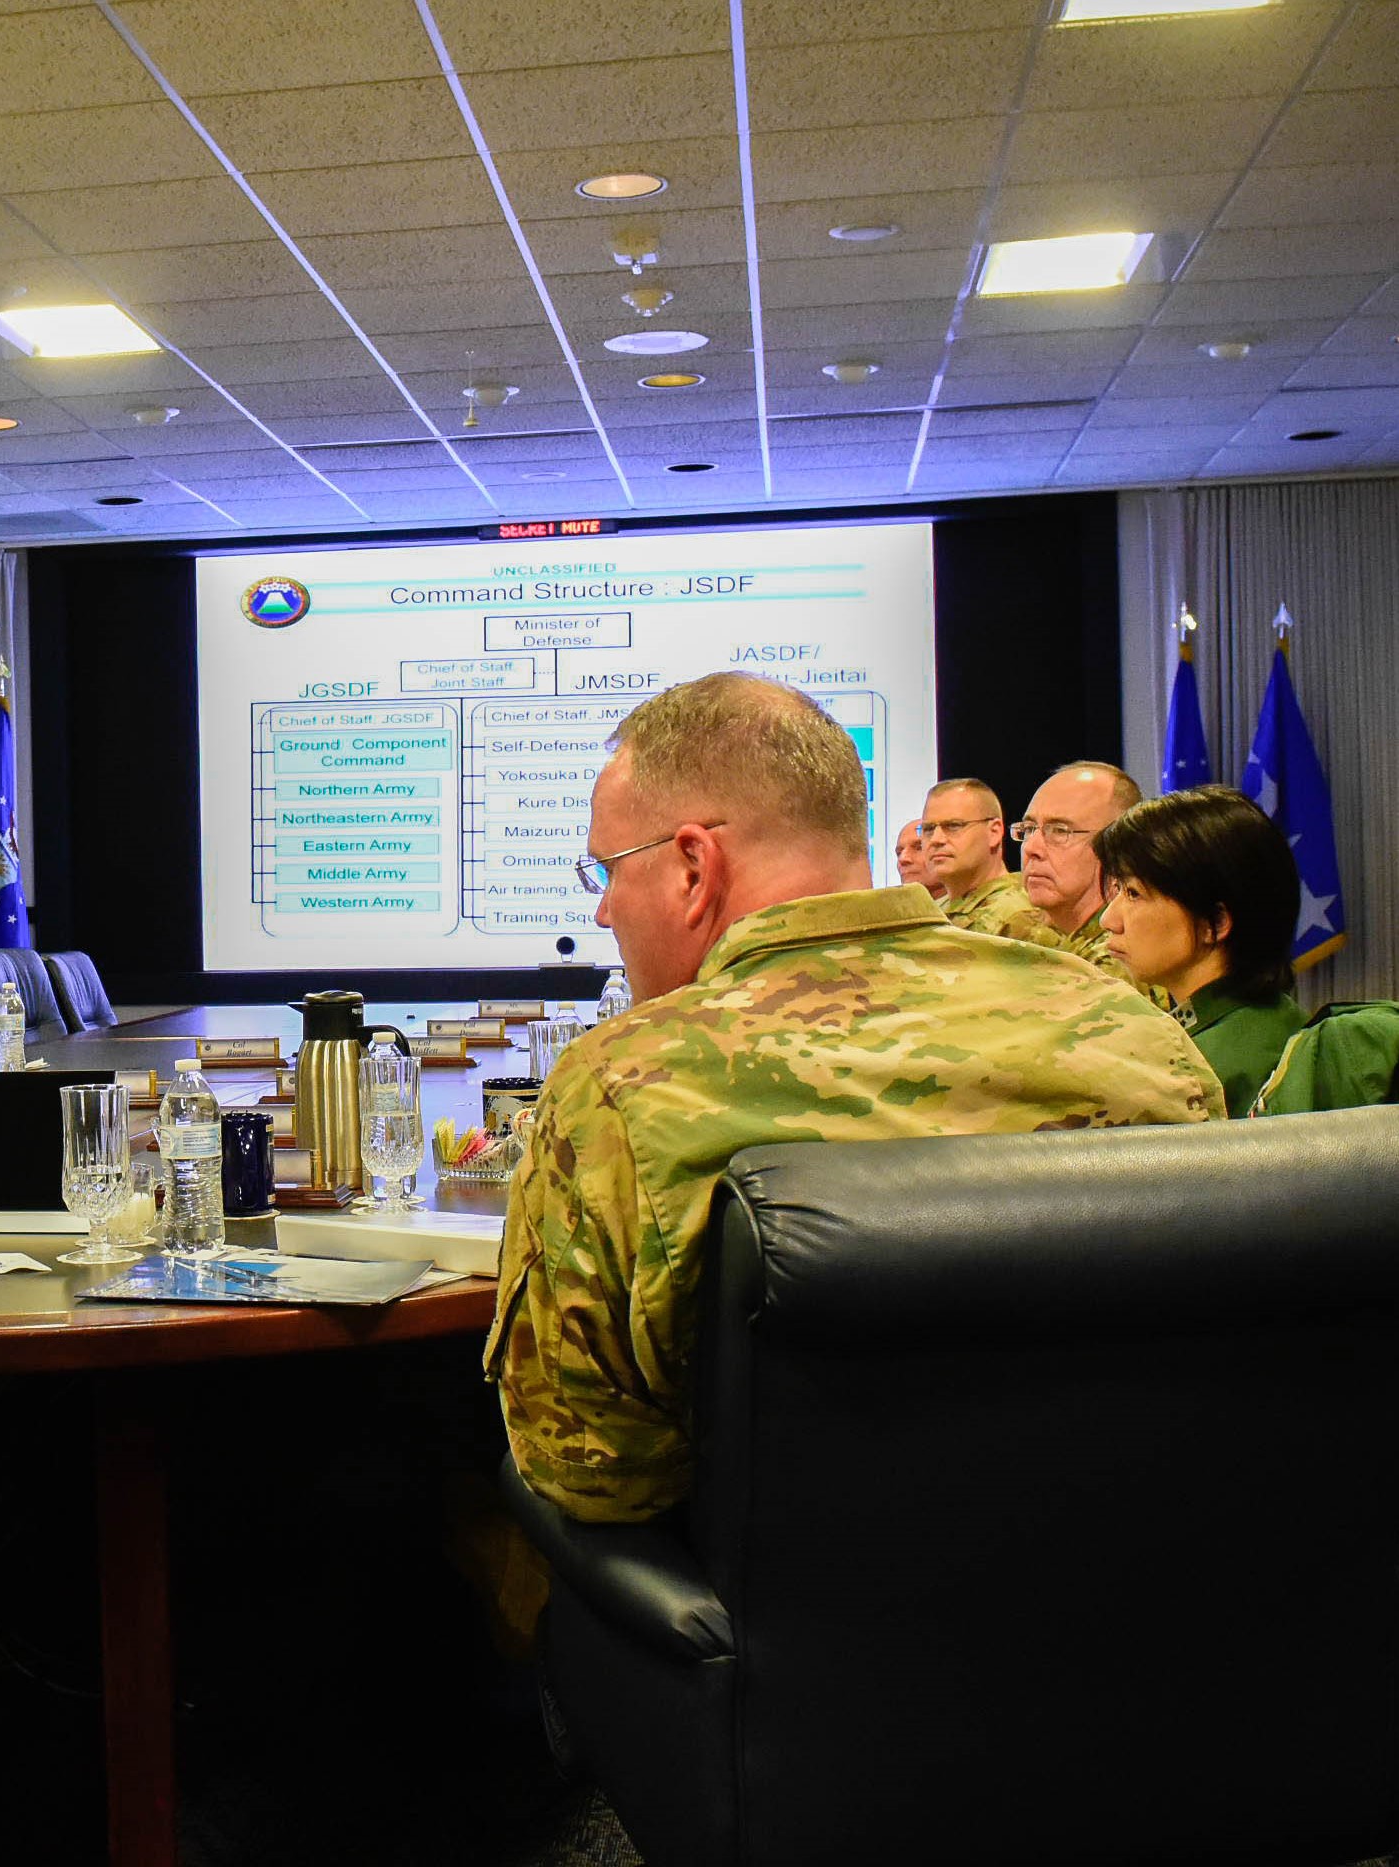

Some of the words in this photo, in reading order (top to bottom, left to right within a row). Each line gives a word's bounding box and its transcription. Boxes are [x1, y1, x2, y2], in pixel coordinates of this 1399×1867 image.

[561, 519, 601, 535] MUTE
[493, 562, 617, 577] UNCLASSIFIED
[390, 582, 523, 605] Command
[534, 580, 654, 602] Structure
[680, 575, 755, 595] JSDF
[514, 617, 578, 631] Minister
[585, 617, 601, 630] of
[522, 633, 592, 648] Defense
[729, 644, 821, 663] JASDF/
[417, 662, 452, 675] Chief
[458, 661, 474, 674] of
[431, 677, 466, 690] Joint
[470, 676, 506, 688] Staff
[575, 673, 661, 690] JMSDF
[298, 681, 380, 699] JGSDF
[279, 715, 317, 727] Chief
[321, 714, 335, 725] of
[381, 712, 435, 724] JGSDF
[491, 710, 531, 722] Chief
[535, 710, 549, 721] of
[597, 707, 632, 720] JMS
[280, 738, 341, 752] Ground
[352, 737, 447, 753] Component
[492, 740, 599, 753] Self-Defense
[321, 754, 405, 768] Command
[498, 769, 578, 782] Yokosuka
[299, 784, 369, 797] Northern
[373, 783, 416, 798] Army
[518, 796, 557, 809] Kure
[282, 812, 387, 825] Northeastern
[390, 811, 434, 825] Army
[504, 826, 570, 838] Maizuru
[303, 839, 365, 852] Eastern
[369, 839, 412, 853] Army
[502, 854, 573, 867] Ominato
[307, 868, 361, 881] Middle
[365, 867, 408, 882] Army
[488, 884, 509, 895] Air
[513, 883, 567, 897] training
[301, 896, 369, 909] Western
[372, 896, 415, 910] Army
[493, 911, 559, 926] Training
[232, 1040, 246, 1049] Col
[417, 1038, 432, 1047] Col
